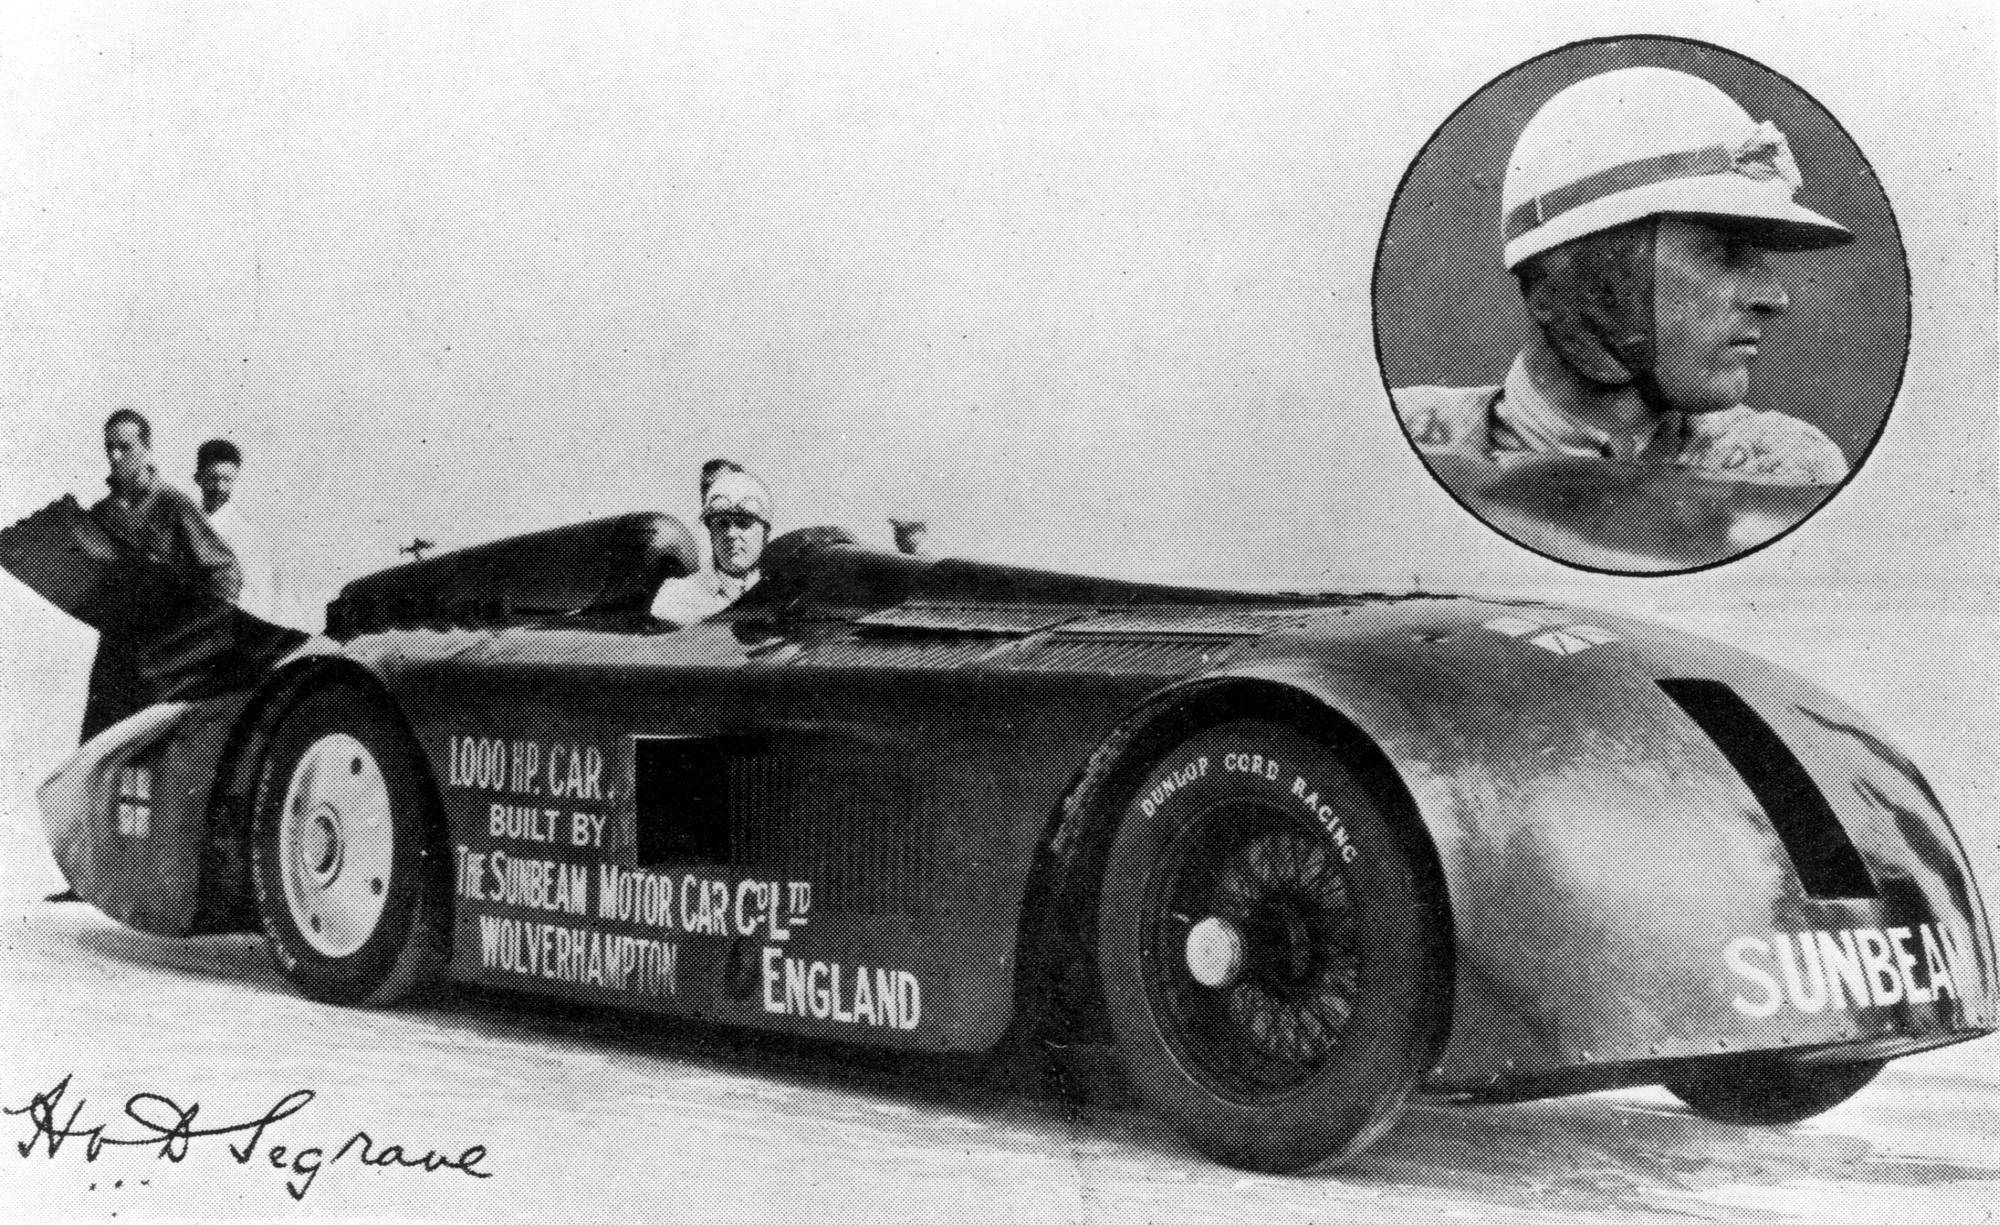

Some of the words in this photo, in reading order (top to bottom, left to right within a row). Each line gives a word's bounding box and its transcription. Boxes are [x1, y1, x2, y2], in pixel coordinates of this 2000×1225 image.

[489, 803, 560, 843] BUILT
[573, 811, 606, 848] BY
[1140, 755, 1210, 819] DUNLOP
[1224, 752, 1280, 782] CORD
[1289, 775, 1359, 864] RACING
[680, 873, 730, 937] CAR
[480, 914, 677, 995] WOLVERHAMPTON
[762, 946, 921, 1031] ENGLAND
